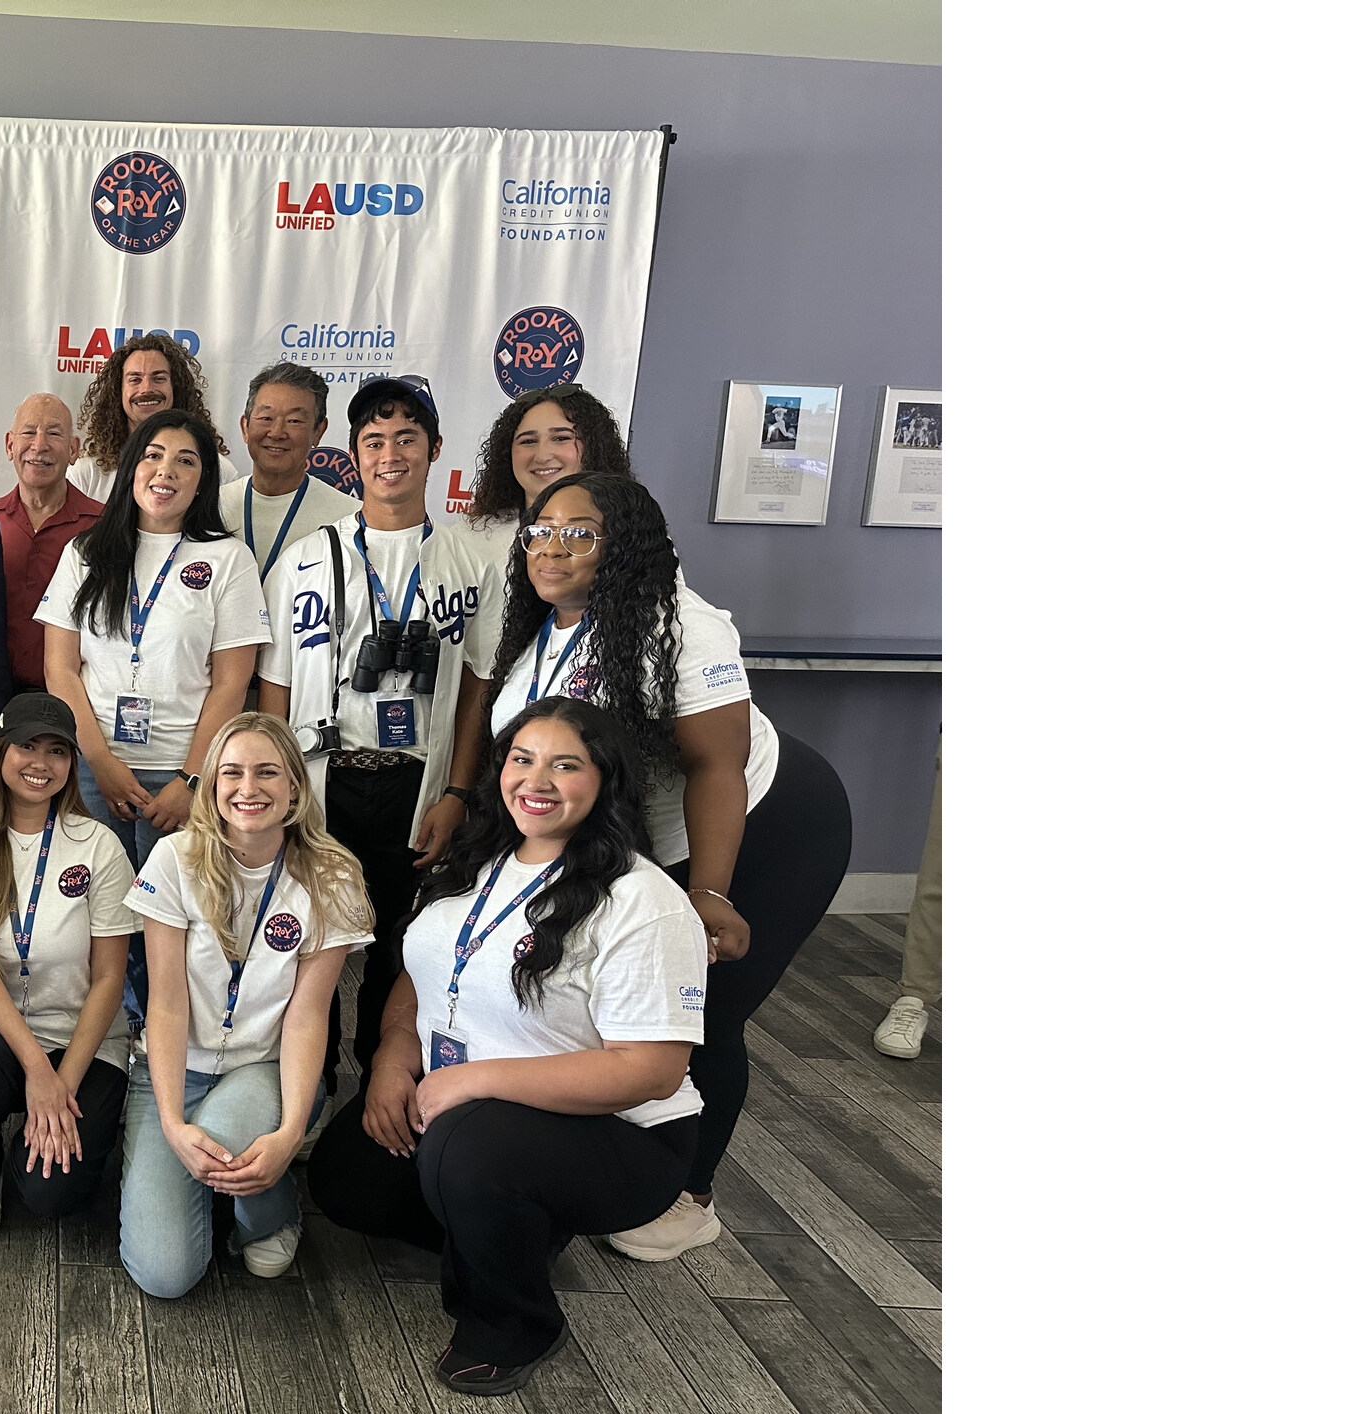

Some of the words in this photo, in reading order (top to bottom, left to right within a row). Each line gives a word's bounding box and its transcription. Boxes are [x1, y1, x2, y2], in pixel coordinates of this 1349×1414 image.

[100, 157, 179, 195] ROOKIE
[277, 182, 424, 216] LAUSD
[502, 180, 610, 205] California
[502, 207, 553, 218] CREDIT
[564, 208, 609, 219] UNION
[276, 216, 335, 231] UNIFIED
[101, 218, 117, 235] OF
[117, 232, 140, 248] THE
[143, 220, 175, 247] YEAR
[501, 227, 606, 241] FOUNDATION
[281, 324, 395, 348] California
[503, 311, 579, 347] ROOKIE
[281, 351, 335, 361] CREDIT
[346, 352, 393, 361] UNION
[57, 359, 104, 374] UNIFIE
[501, 369, 512, 385] OF
[702, 662, 739, 677] California
[707, 677, 742, 688] FOUNDATION
[269, 915, 300, 931] ROOKIE
